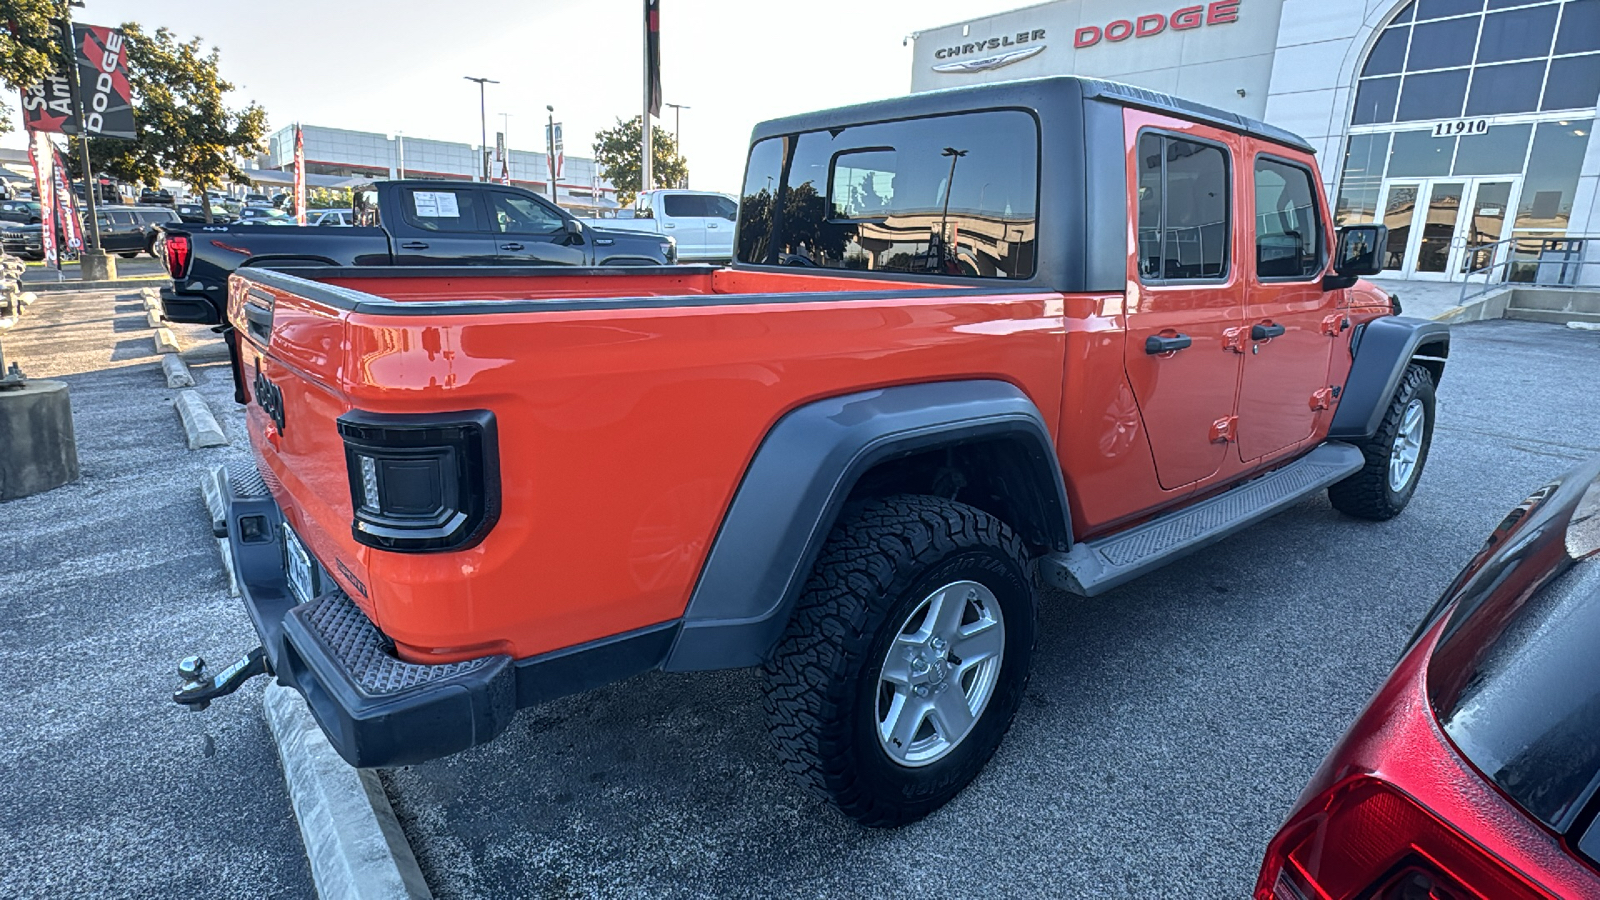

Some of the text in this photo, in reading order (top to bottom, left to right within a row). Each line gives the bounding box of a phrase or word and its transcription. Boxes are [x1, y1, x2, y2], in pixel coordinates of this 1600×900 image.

[934, 28, 1046, 60] CHRYSLER
[1073, 0, 1241, 49] DODGE
[23, 77, 48, 111] Sa
[87, 31, 123, 134] DODGE
[1435, 119, 1487, 136] 11910
[253, 356, 286, 438] Jeep
